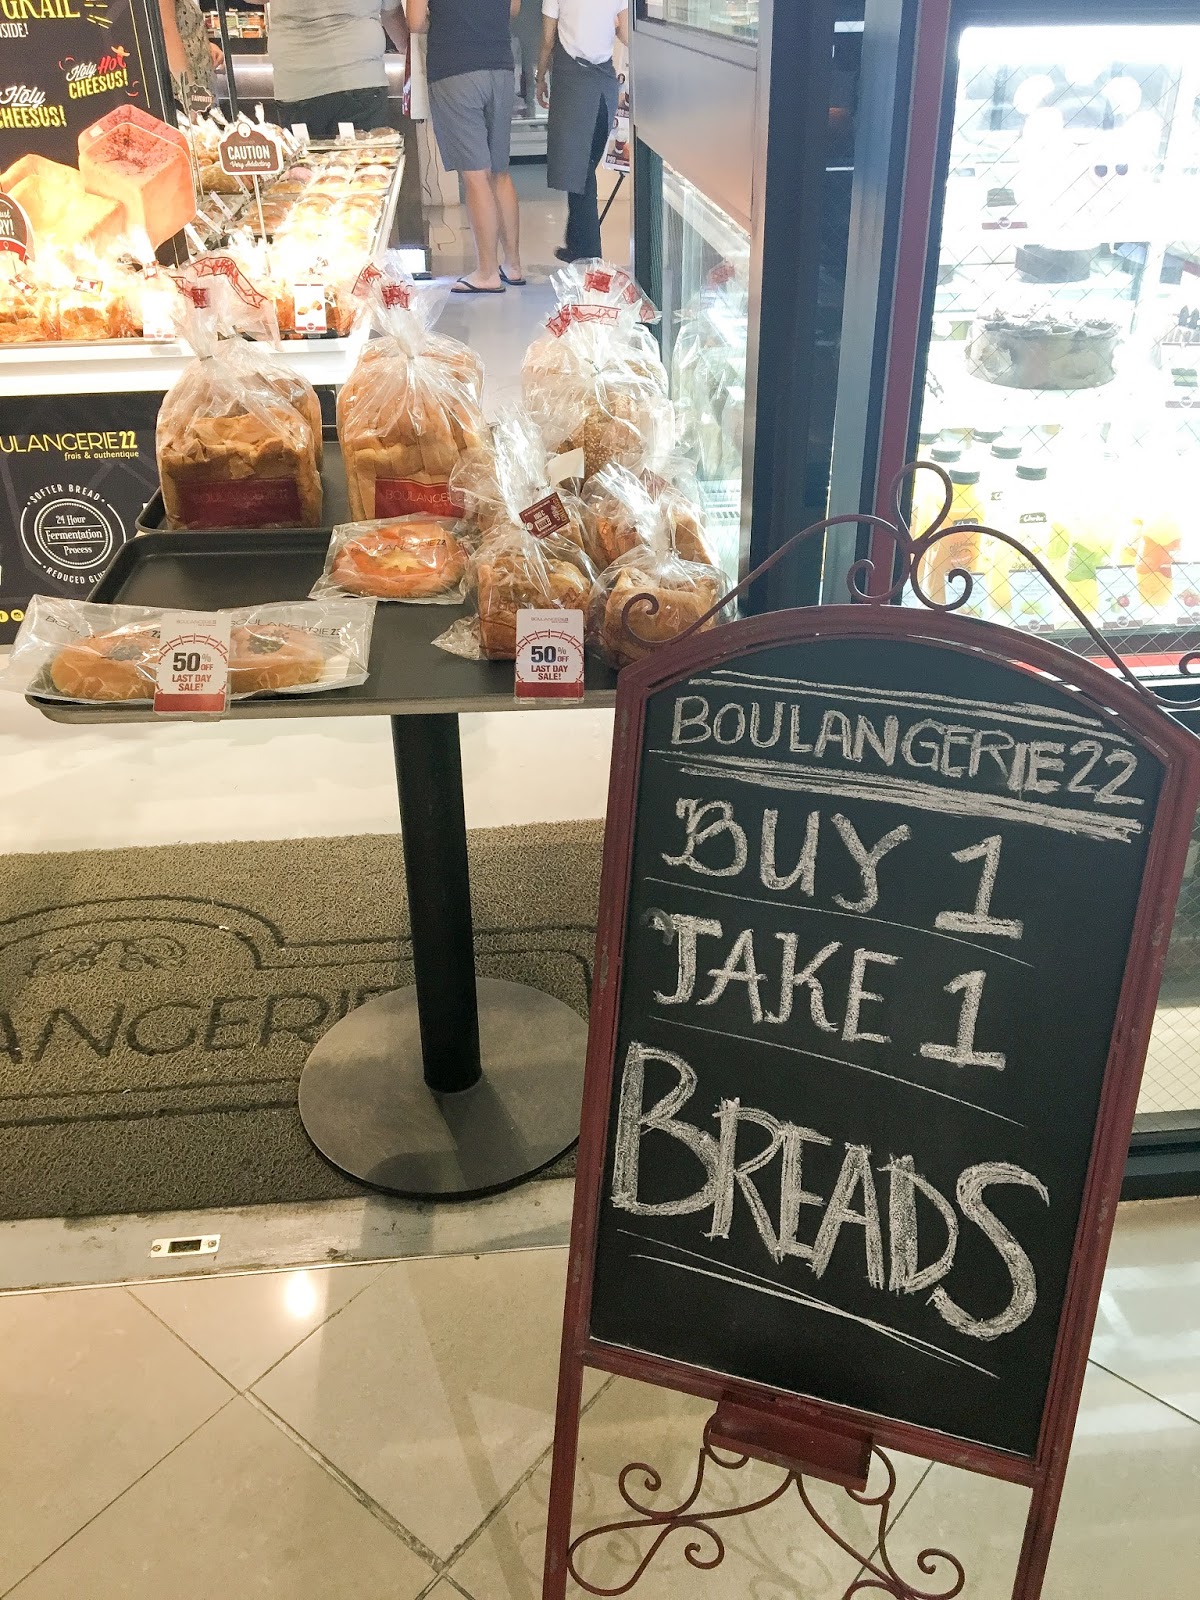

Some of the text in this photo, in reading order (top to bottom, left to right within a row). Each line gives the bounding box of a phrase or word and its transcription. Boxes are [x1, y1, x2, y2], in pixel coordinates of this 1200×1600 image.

[66, 62, 97, 81] Holy
[68, 68, 129, 99] CHEESUS!
[0, 85, 46, 109] Holy
[227, 145, 270, 160] CAUTION
[64, 452, 81, 461] frais
[93, 451, 139, 459] authentique
[29, 484, 101, 504] SOFTER BREAD
[56, 514, 86, 525] 24 Hour
[45, 529, 103, 542] Fermentation
[63, 546, 93, 556] Process
[46, 566, 86, 584] REDUCED
[557, 655, 570, 663] OFF
[200, 663, 214, 671] OFF
[531, 665, 569, 673] LAST DAY
[172, 674, 212, 682] LAST DAY
[537, 673, 562, 681] SALE!
[178, 683, 204, 691] SALE!
[670, 695, 1146, 805] BOULANGERIE22
[661, 797, 1024, 939] BUY 1
[649, 912, 1006, 1070] TAKE 1
[610, 1040, 1050, 1342] BREADS
